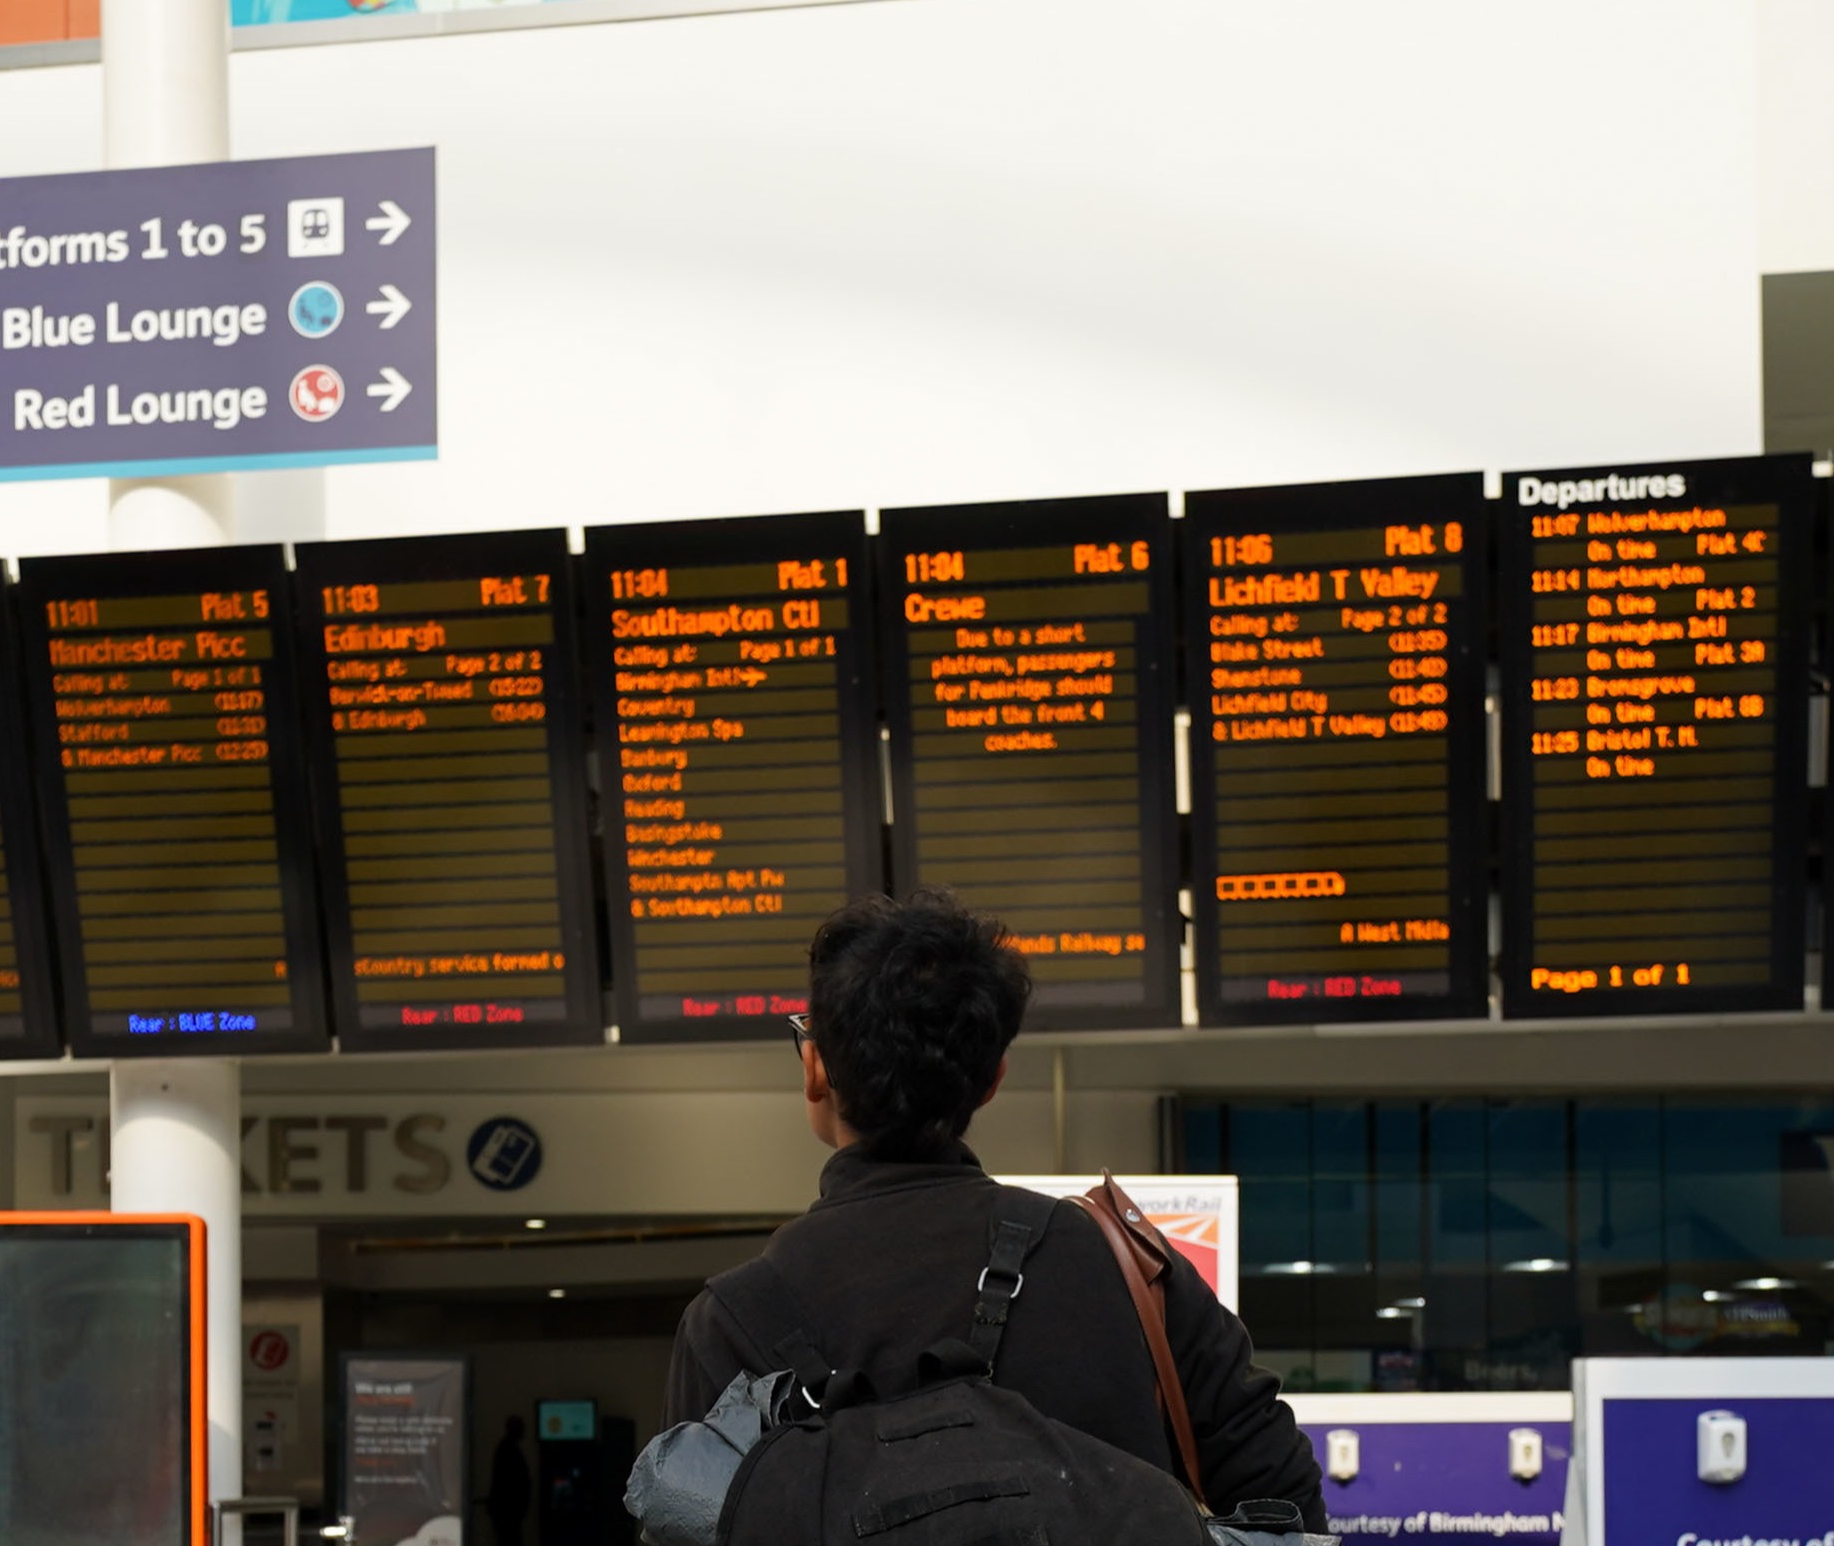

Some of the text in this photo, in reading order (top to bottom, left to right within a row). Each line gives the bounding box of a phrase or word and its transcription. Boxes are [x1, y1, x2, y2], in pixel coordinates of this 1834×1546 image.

[140, 218, 167, 260] 1
[179, 218, 226, 258] to
[240, 215, 266, 253] 5
[3, 300, 267, 349] Blue Lounge
[15, 383, 267, 430] Red Lounge
[1517, 473, 1686, 511] Departures
[1073, 545, 1124, 575] Plat
[1208, 534, 1273, 567] 11:06
[1385, 525, 1436, 557] Plat
[777, 560, 828, 591] Plat
[1208, 564, 1440, 608] Lichfield T Valley
[611, 606, 774, 639] Southampton
[904, 593, 986, 623] Crewe
[48, 635, 188, 665] Manchester
[323, 620, 446, 653] Edinburgh
[993, 627, 1015, 647] to
[1035, 623, 1085, 644] short
[1016, 650, 1116, 675] passengers
[934, 683, 966, 703] for
[1056, 673, 1113, 696] should
[946, 706, 998, 727] board
[1001, 705, 1033, 725] the
[1037, 703, 1087, 724] front
[1531, 962, 1690, 993] Page 1 of 1
[29, 1113, 453, 1195] TIETS
[1328, 1513, 1402, 1538] ourtesy
[1404, 1511, 1428, 1533] of
[1430, 1511, 1549, 1538] Birmingham
